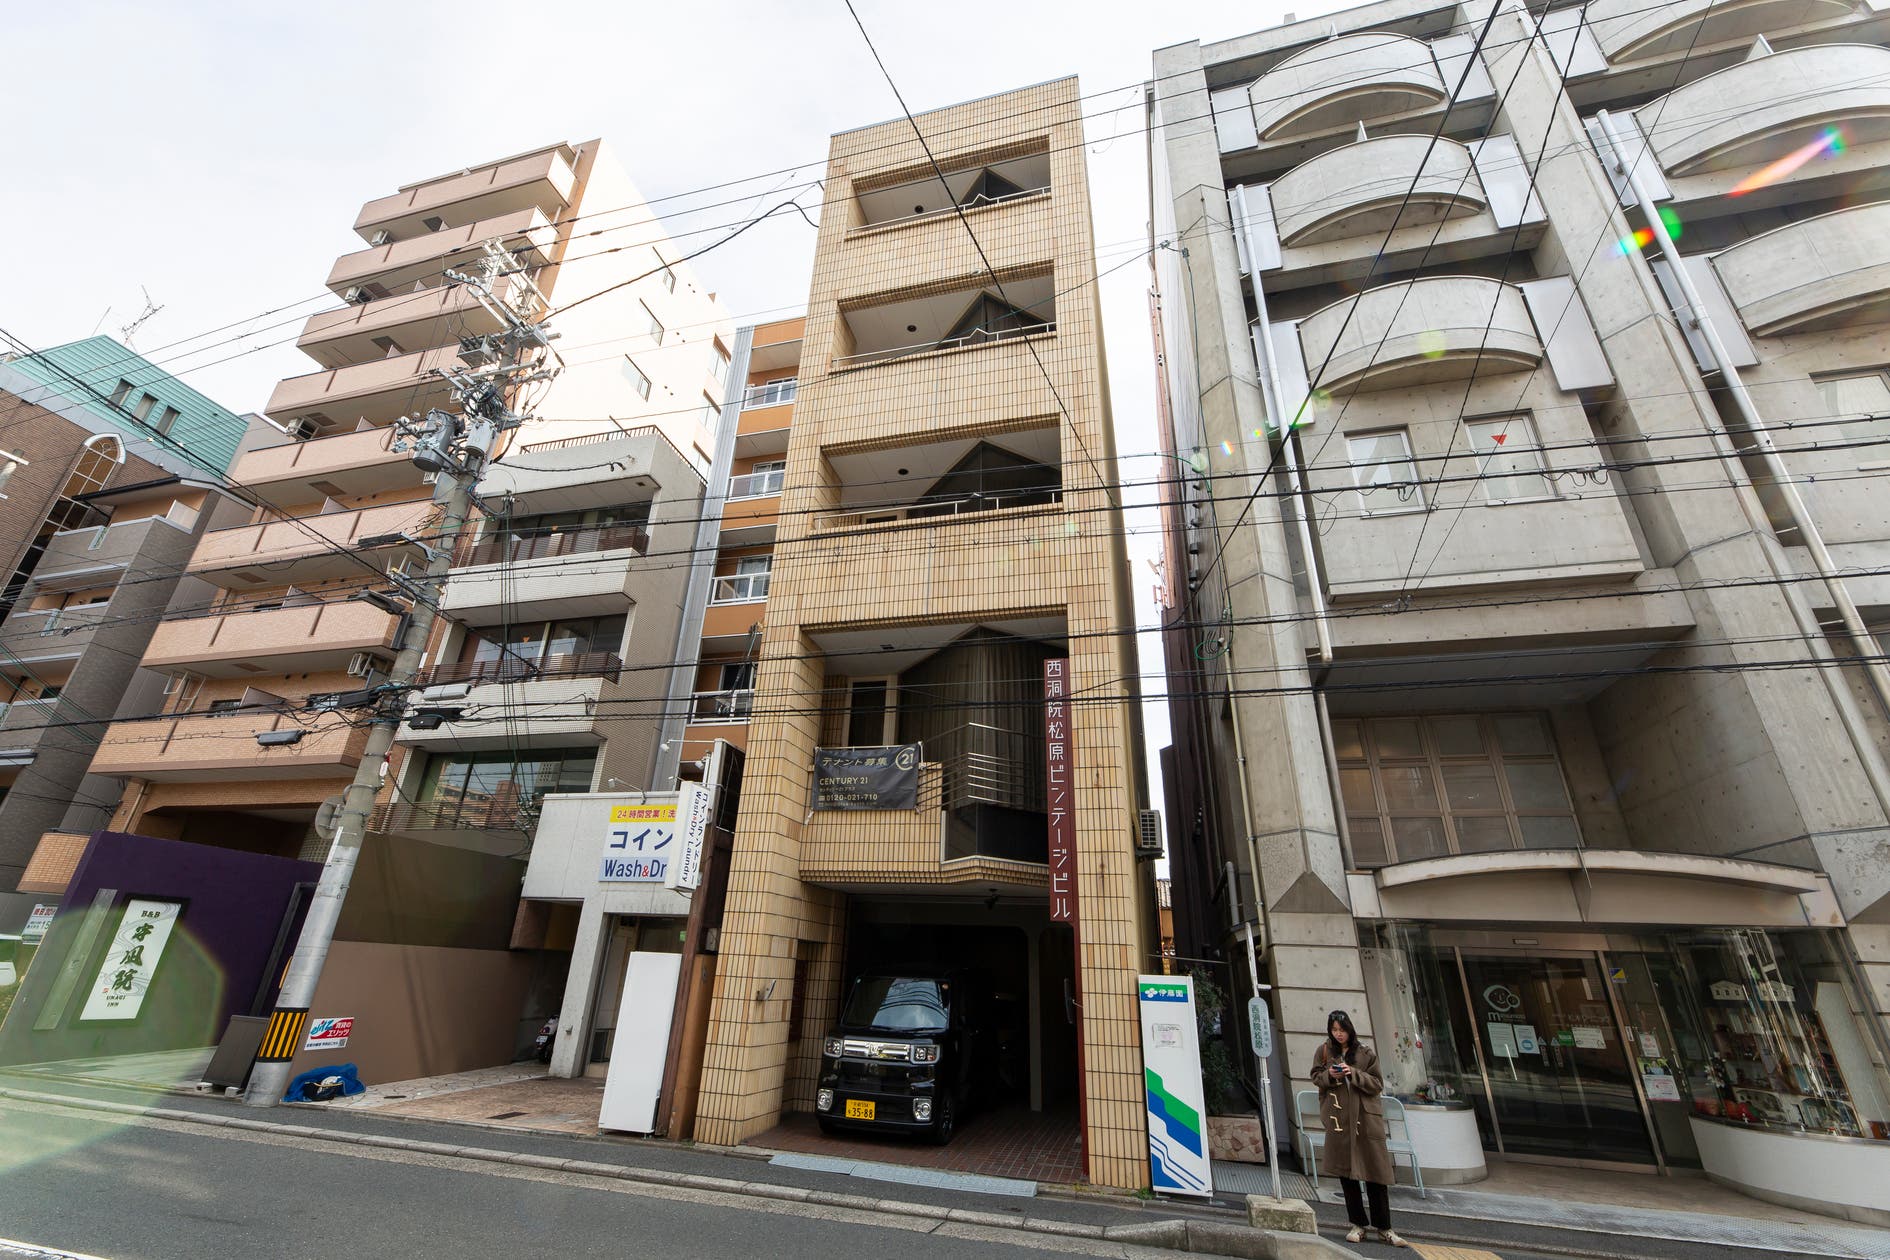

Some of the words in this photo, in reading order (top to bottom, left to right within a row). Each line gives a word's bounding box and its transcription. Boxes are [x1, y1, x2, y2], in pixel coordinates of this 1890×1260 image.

[822, 757, 888, 767] テナント募集
[819, 777, 858, 785] CENTURY
[860, 776, 868, 784] 21
[1046, 660, 1070, 918] 西洞院松原ビンテージビル
[826, 793, 878, 801] 0120-021-710
[610, 829, 673, 851] コイン
[681, 841, 694, 882] Laundry
[141, 910, 161, 918] B&B
